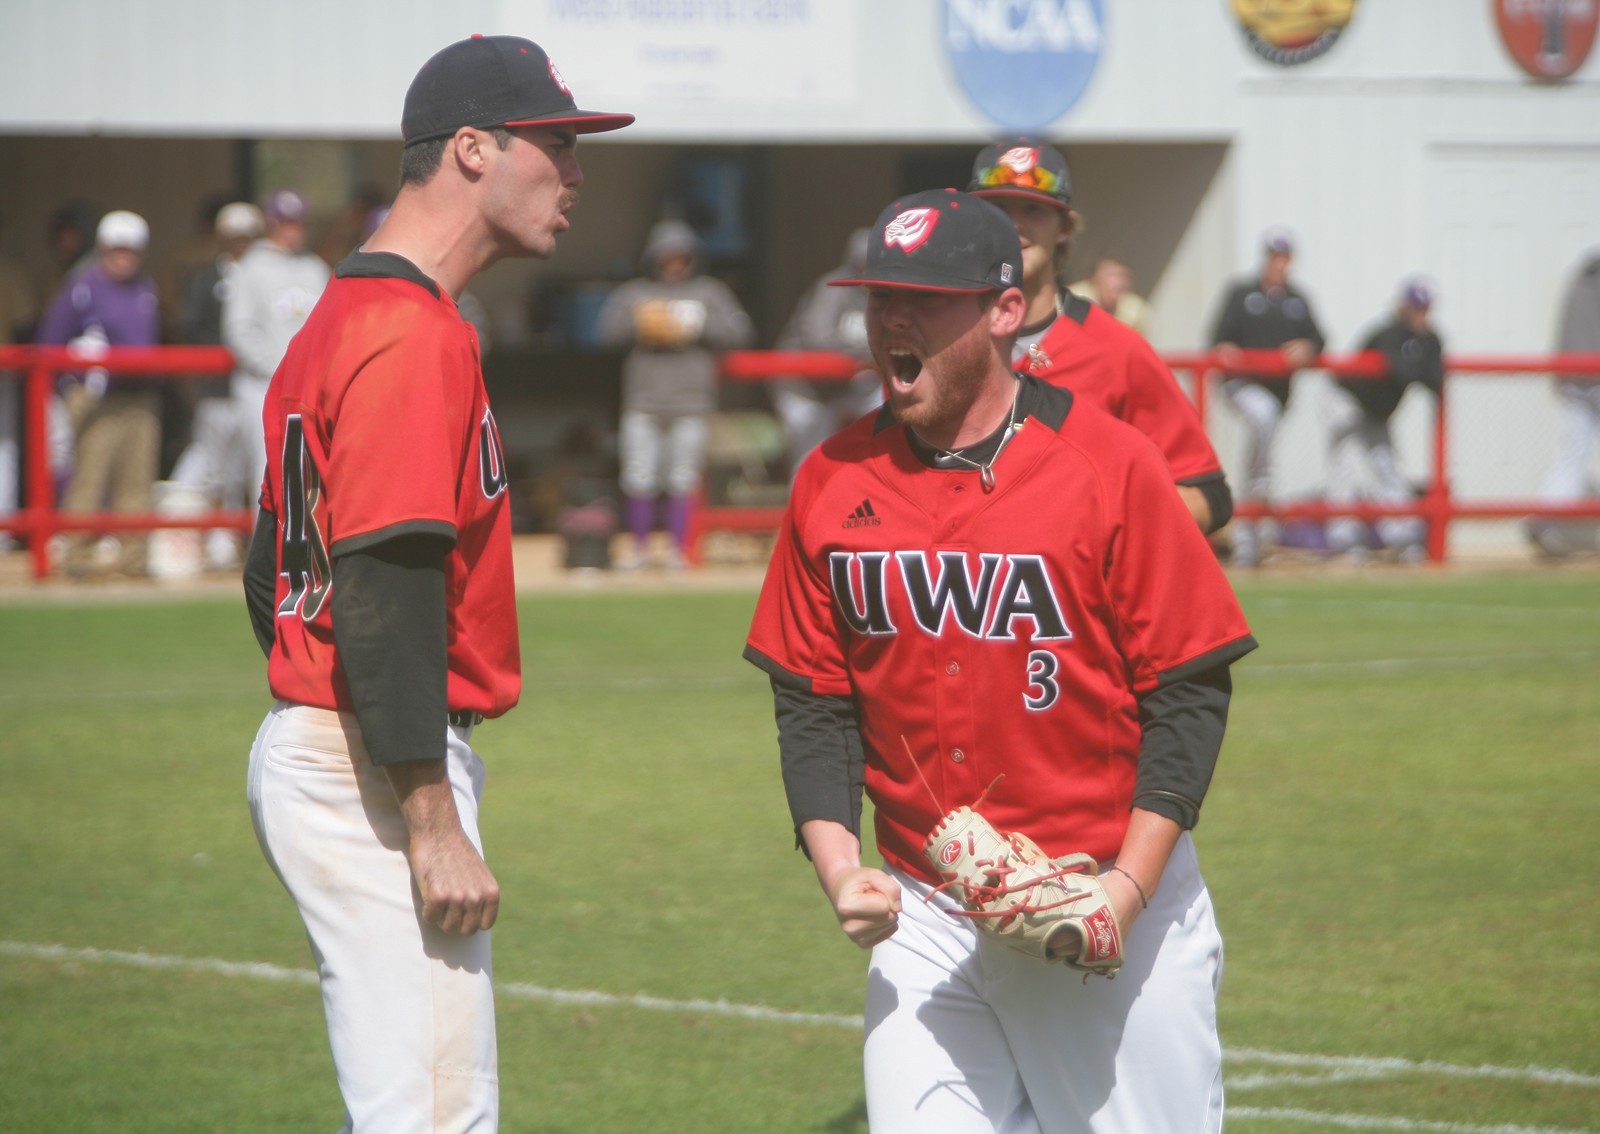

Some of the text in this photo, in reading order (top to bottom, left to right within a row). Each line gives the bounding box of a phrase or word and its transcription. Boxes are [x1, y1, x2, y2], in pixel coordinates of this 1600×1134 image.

[841, 516, 881, 529] adidas
[829, 550, 1073, 641] UWA
[1022, 650, 1060, 711] 3
